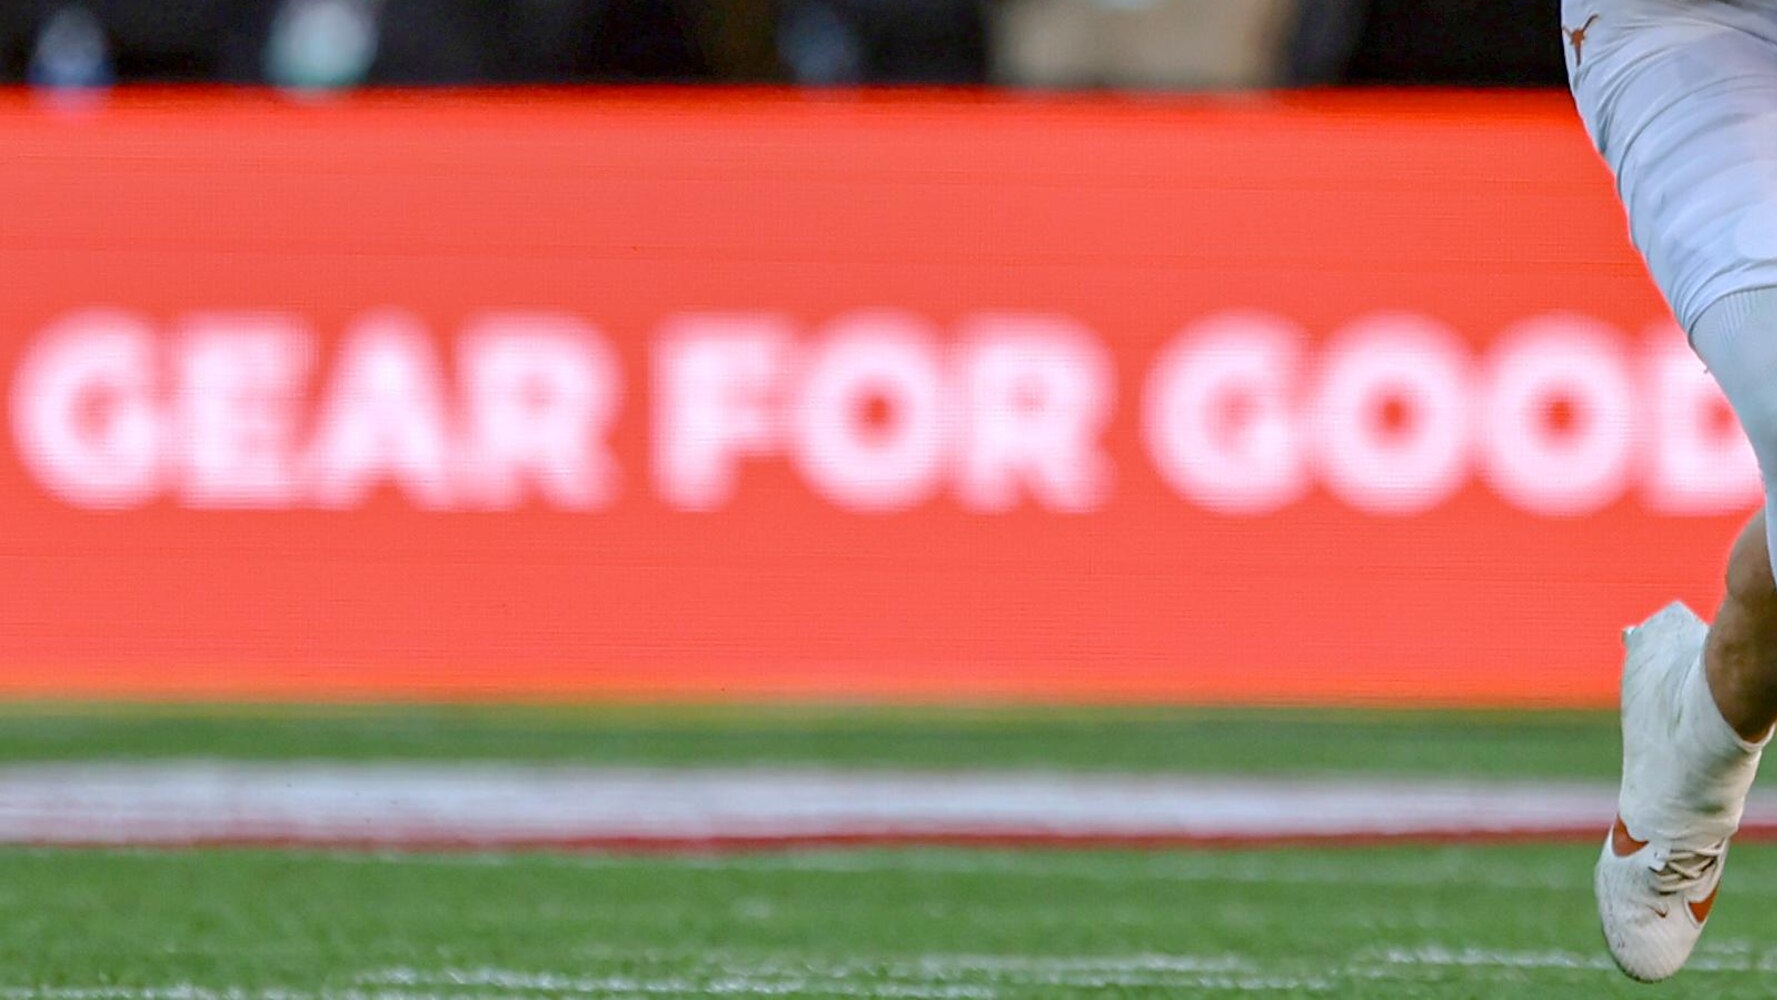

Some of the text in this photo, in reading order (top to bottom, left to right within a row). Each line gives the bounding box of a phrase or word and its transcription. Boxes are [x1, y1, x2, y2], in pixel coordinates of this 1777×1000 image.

[8, 306, 1764, 516] GEAR FOR GOOD
